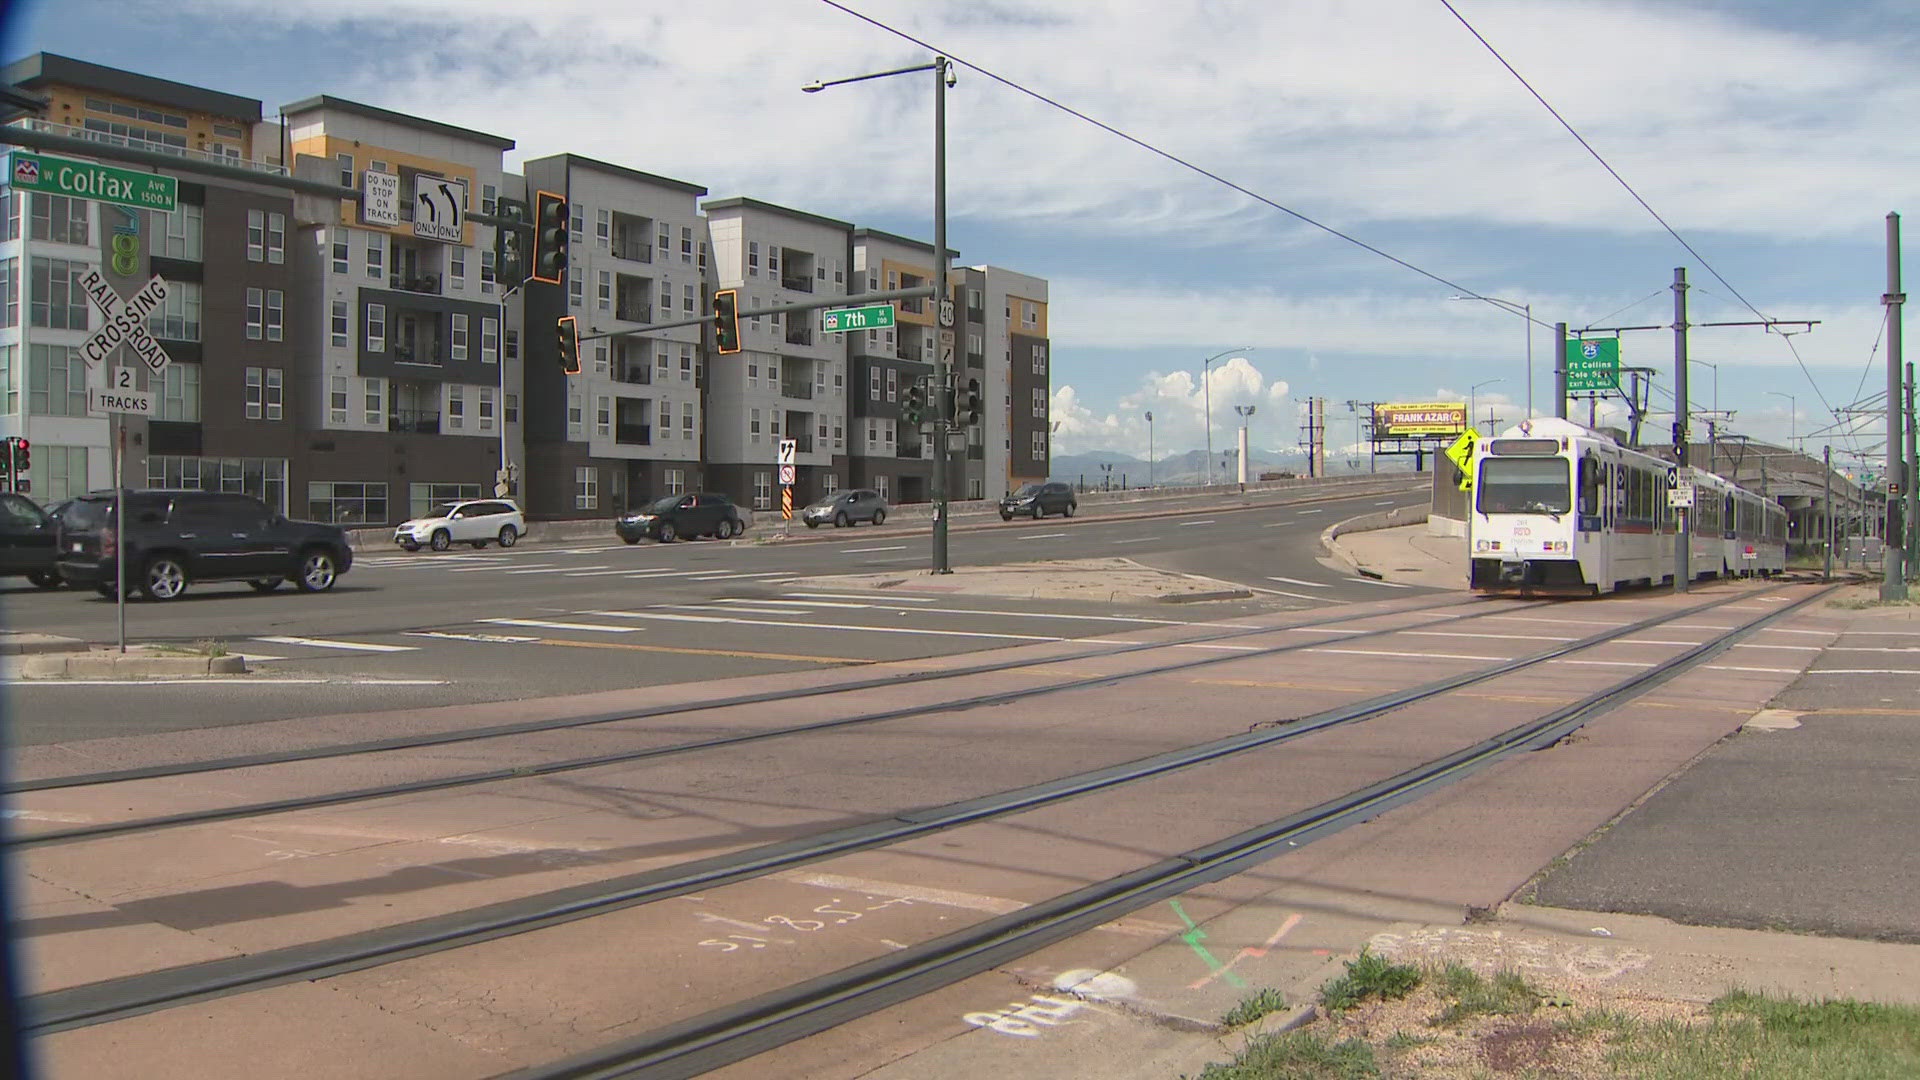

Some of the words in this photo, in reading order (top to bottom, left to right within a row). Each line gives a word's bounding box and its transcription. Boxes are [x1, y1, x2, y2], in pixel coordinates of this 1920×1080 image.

[44, 170, 54, 181] W
[59, 167, 133, 200] Colfax
[148, 180, 166, 192] Ave
[368, 175, 379, 185] DO
[382, 178, 397, 188] NOT
[140, 191, 162, 204] 1500
[165, 195, 173, 206] N
[372, 187, 393, 198] STOP
[376, 200, 389, 208] ON
[367, 208, 398, 221] TRACKS
[415, 222, 438, 234] ONLY
[439, 226, 460, 238] ONLY
[82, 271, 118, 315] RAIL
[128, 326, 166, 369] ROAD
[844, 312, 866, 327] 7th
[941, 306, 953, 322] 40
[86, 281, 166, 361] CROSSING
[1584, 345, 1597, 355] 25
[1569, 361, 1578, 369] Ft
[1582, 361, 1612, 369] Collins
[119, 371, 130, 388] 2
[100, 395, 148, 410] TRACKS
[1392, 413, 1424, 422] FRANK
[1424, 413, 1451, 422] AZAR
